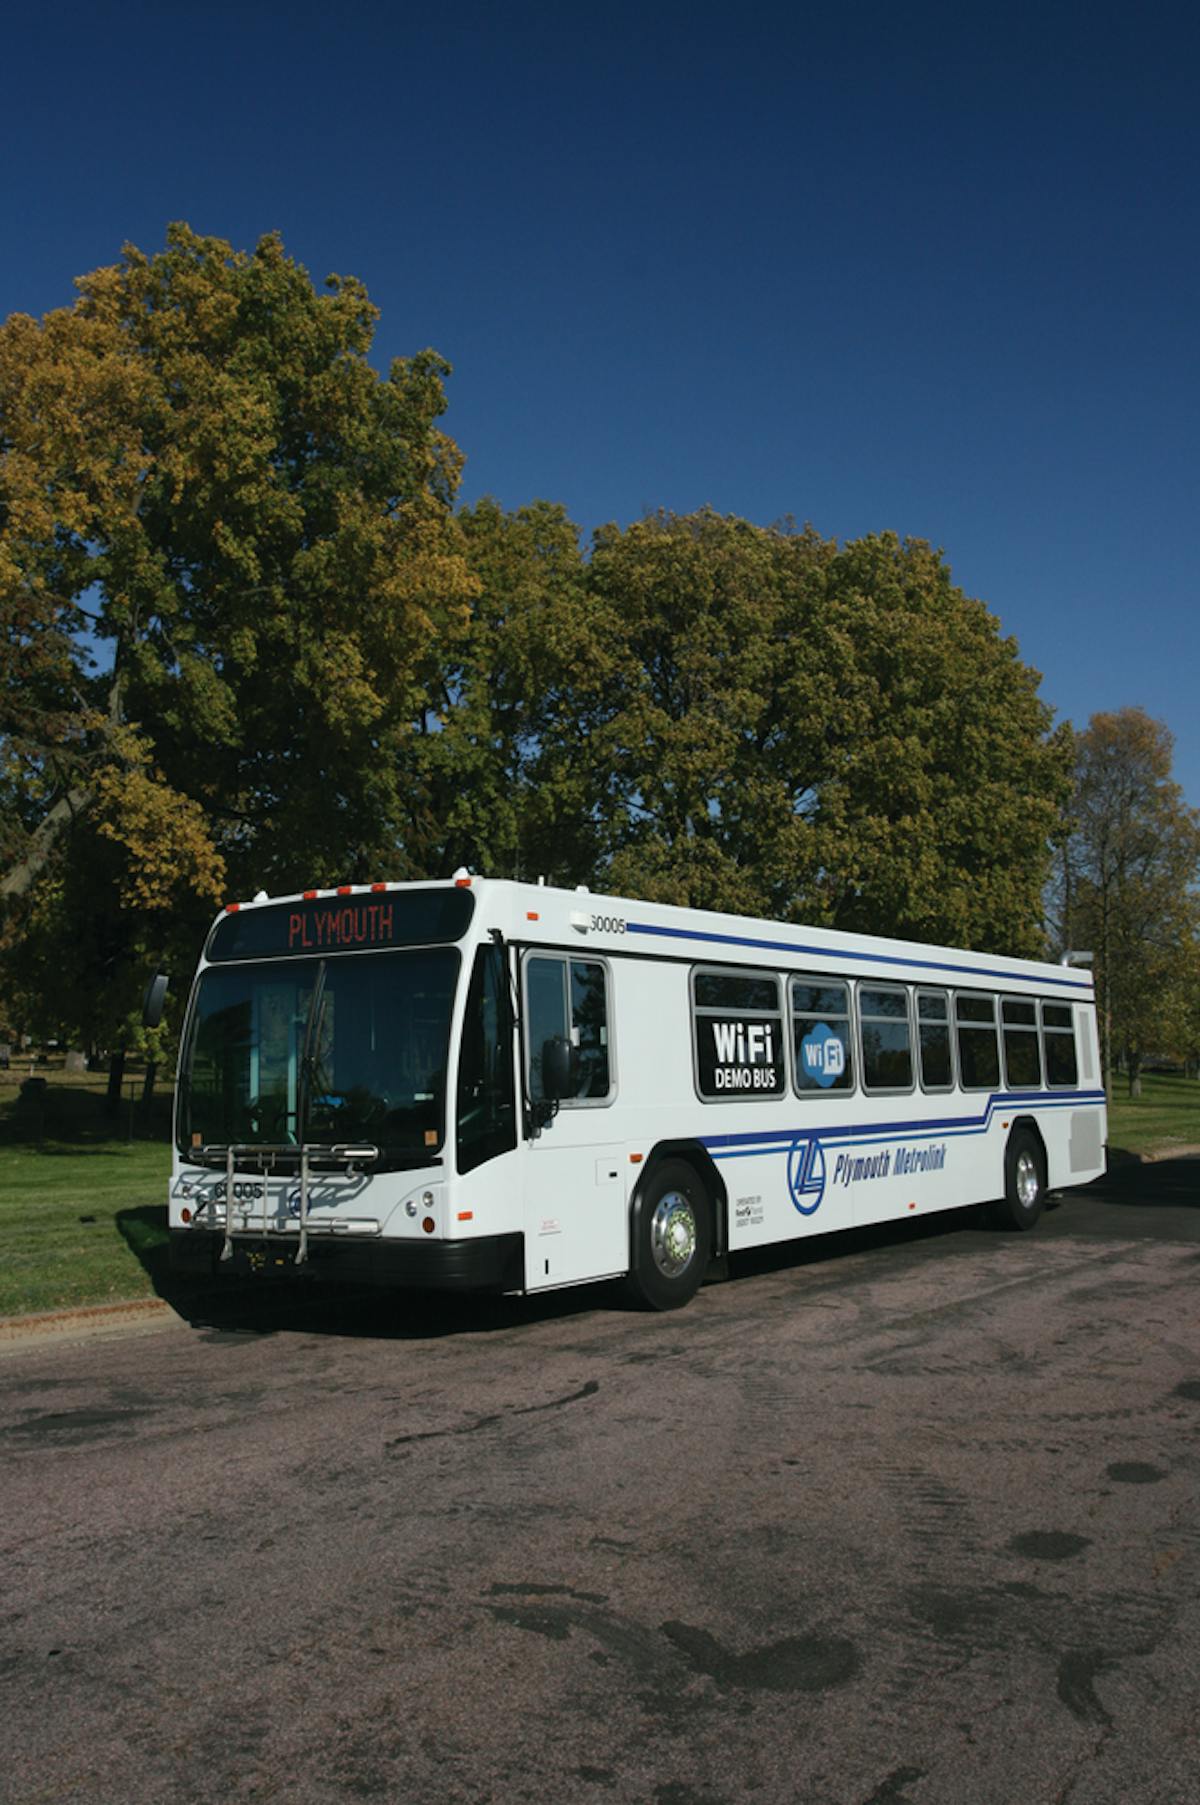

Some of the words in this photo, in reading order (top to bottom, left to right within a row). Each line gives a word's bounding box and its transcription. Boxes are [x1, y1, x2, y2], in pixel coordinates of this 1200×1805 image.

[288, 904, 393, 948] PLYMOUTH
[715, 1068, 751, 1089] DEMO
[753, 1068, 776, 1088] BUS
[833, 1152, 890, 1188] Plymouth
[893, 1143, 947, 1175] Metrolink
[214, 1181, 262, 1199] 6005
